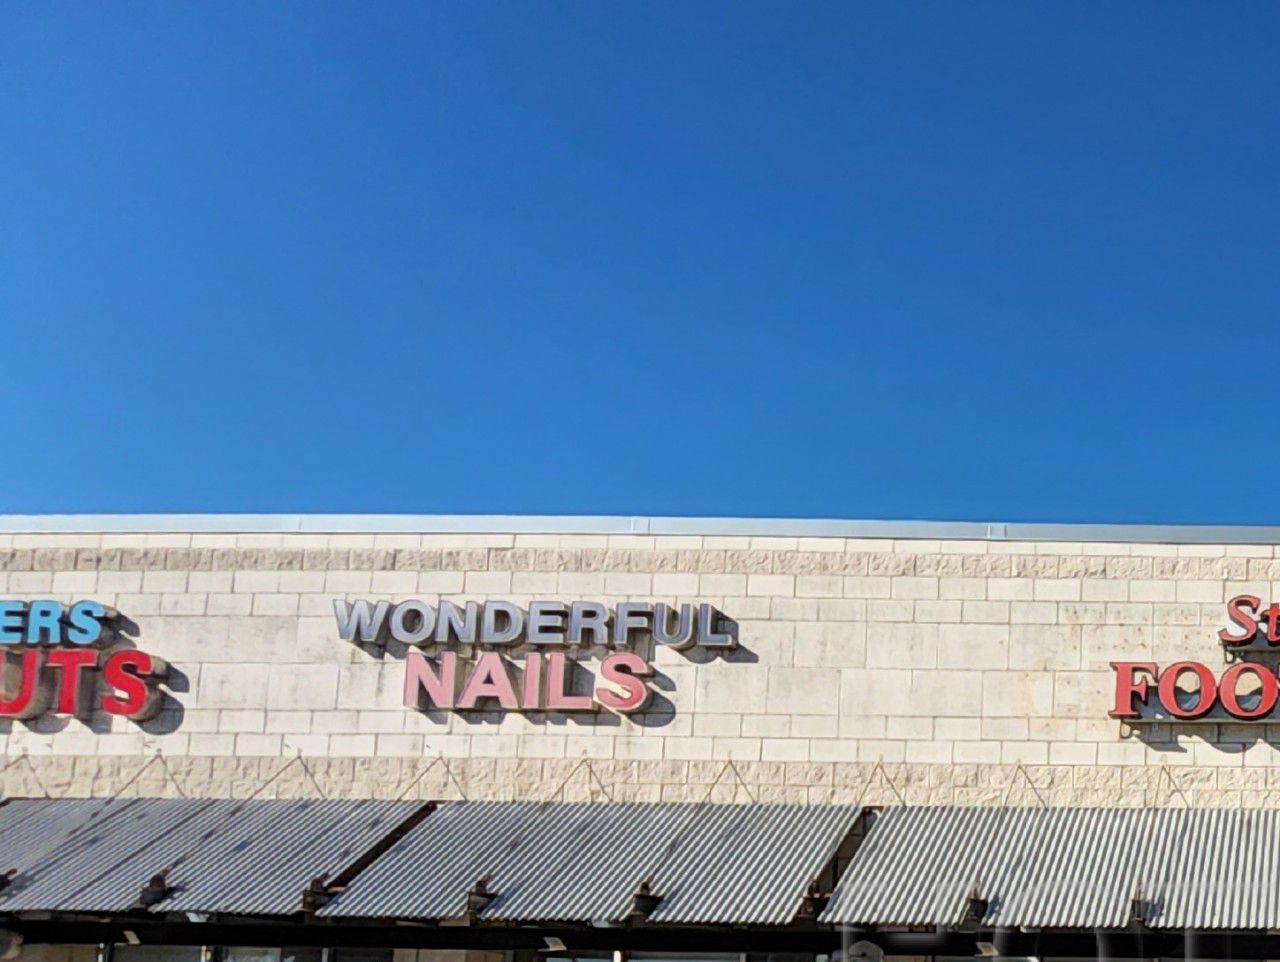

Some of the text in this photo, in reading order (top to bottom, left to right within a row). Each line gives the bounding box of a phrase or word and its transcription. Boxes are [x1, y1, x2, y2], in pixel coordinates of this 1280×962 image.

[0, 600, 105, 645] ERS
[333, 599, 735, 646] WONDERFUL
[0, 648, 154, 716] UTS
[403, 651, 648, 711] NAILS
